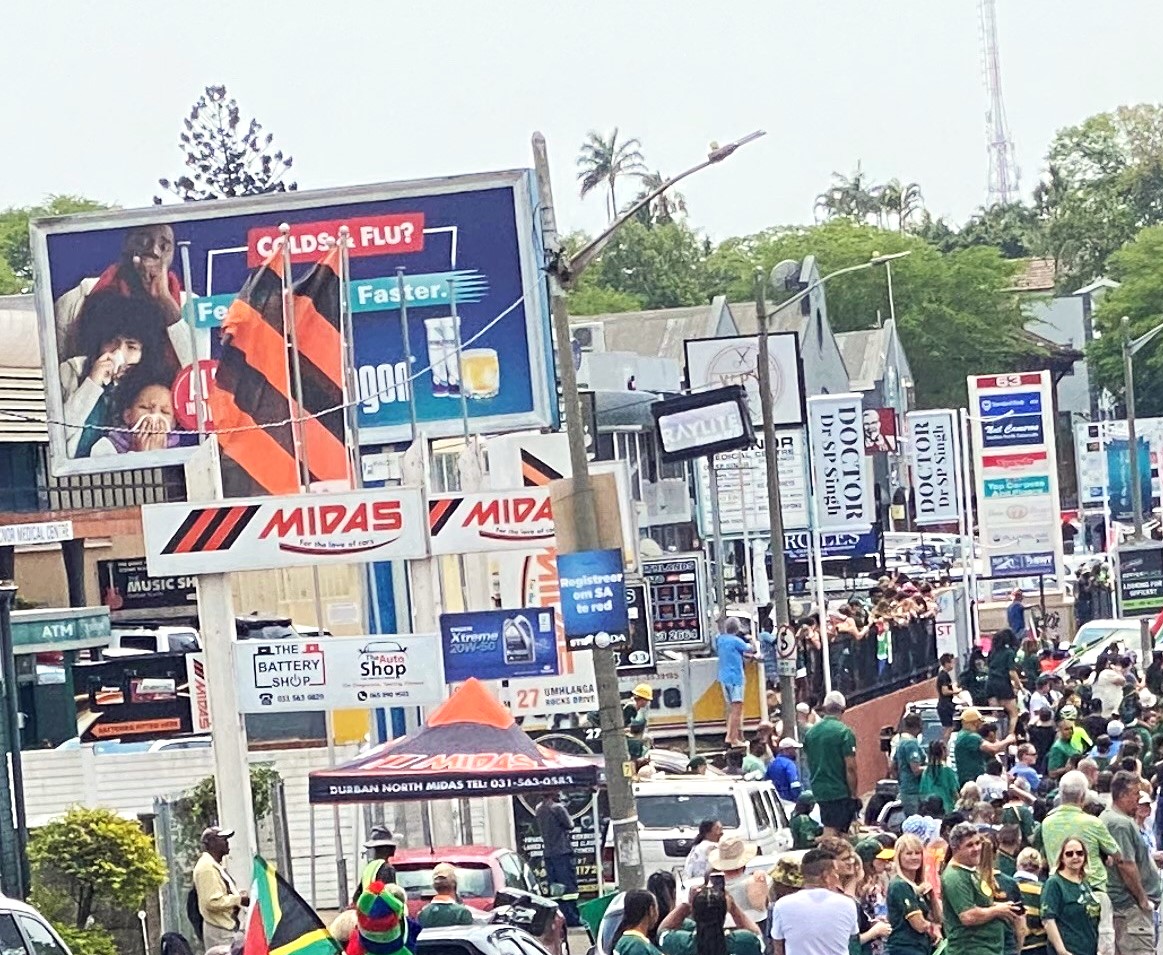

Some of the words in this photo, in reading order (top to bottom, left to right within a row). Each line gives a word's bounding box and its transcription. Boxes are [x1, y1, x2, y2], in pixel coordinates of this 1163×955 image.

[360, 221, 414, 246] FLU?
[358, 283, 448, 304] Faster.
[821, 414, 834, 437] Dr
[823, 441, 837, 463] SP
[933, 425, 948, 465] Singh
[838, 407, 863, 520] DOCTOR
[914, 421, 936, 513] DOCTOR
[936, 470, 948, 489] SP
[825, 467, 841, 515] Singh
[939, 491, 950, 507] Dr
[258, 500, 401, 539] MIDAS
[462, 497, 554, 527] MIDA
[127, 578, 175, 592] MUSIC
[560, 573, 623, 588] Registreer
[573, 591, 593, 600] om
[595, 587, 613, 598] SA
[577, 603, 589, 613] te
[591, 600, 613, 612] red
[42, 623, 73, 638] ATM
[450, 631, 500, 643] Xtreme
[275, 645, 299, 654] THE
[258, 659, 320, 673] BATTERY
[379, 655, 405, 663] Auto
[360, 661, 407, 679] Shop
[272, 674, 310, 687] SHOP
[195, 678, 210, 729] MIDAS
[517, 688, 540, 709] 27
[544, 684, 595, 697] UMHLANGA
[421, 752, 538, 770] MIDAS
[329, 785, 379, 795] DURBAN
[382, 781, 423, 793] NORTH
[426, 780, 465, 790] MIDAS
[466, 779, 488, 789] TEL:
